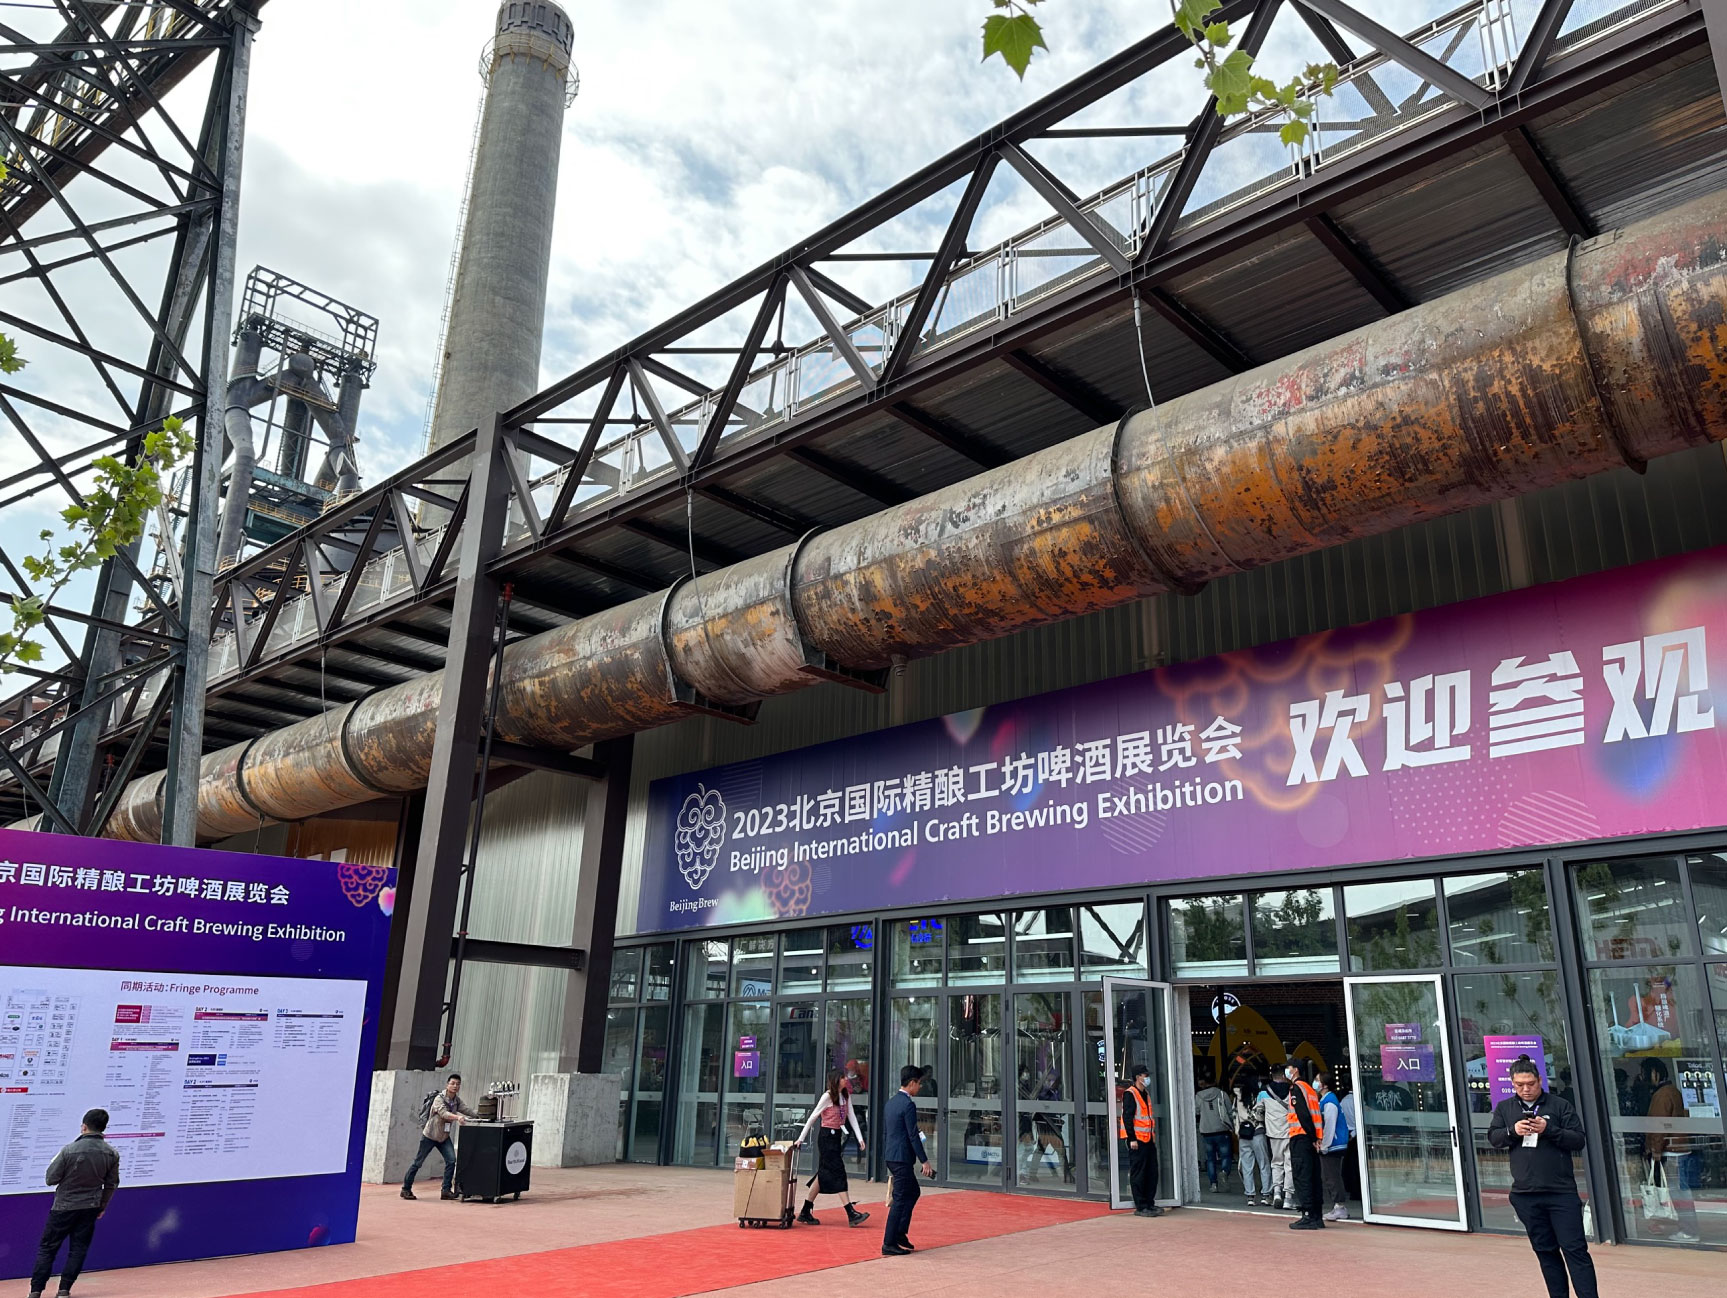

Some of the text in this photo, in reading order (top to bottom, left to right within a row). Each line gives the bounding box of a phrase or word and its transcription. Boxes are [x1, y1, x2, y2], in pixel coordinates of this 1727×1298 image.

[1286, 626, 1715, 786] 欢迎参观
[732, 715, 1244, 841] 2023北京国际精酿工坊啤酒展览会
[730, 779, 1244, 875] Beijing International Craft Brewing Exhibition
[669, 897, 719, 914] BeijingBrew
[10, 906, 139, 929] International
[144, 914, 189, 933] Craft
[193, 919, 263, 941] Brewing
[267, 924, 346, 942] Exhibition
[203, 985, 259, 996] Programme
[741, 1060, 753, 1070] 入口
[1397, 1057, 1420, 1071] 入口
